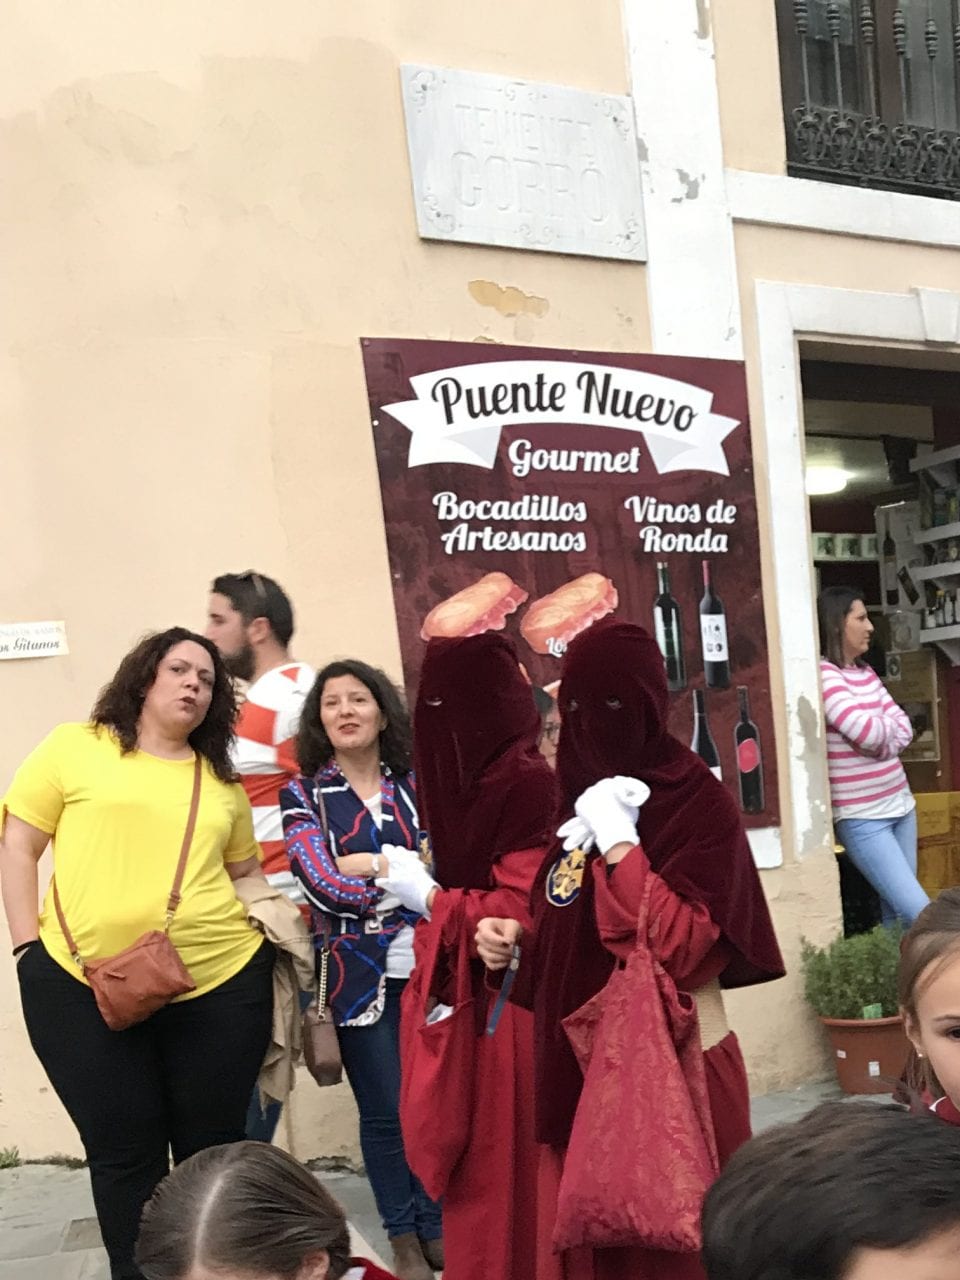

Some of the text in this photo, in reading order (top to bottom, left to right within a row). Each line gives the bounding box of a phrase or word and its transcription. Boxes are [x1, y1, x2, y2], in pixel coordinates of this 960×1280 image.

[431, 370, 698, 432] Puente Nuevo
[507, 439, 641, 477] Gourmet
[432, 491, 588, 522] Bocadillos
[624, 495, 737, 524] Vinos de
[440, 523, 587, 554] Artesanos
[639, 525, 728, 553] Ronda
